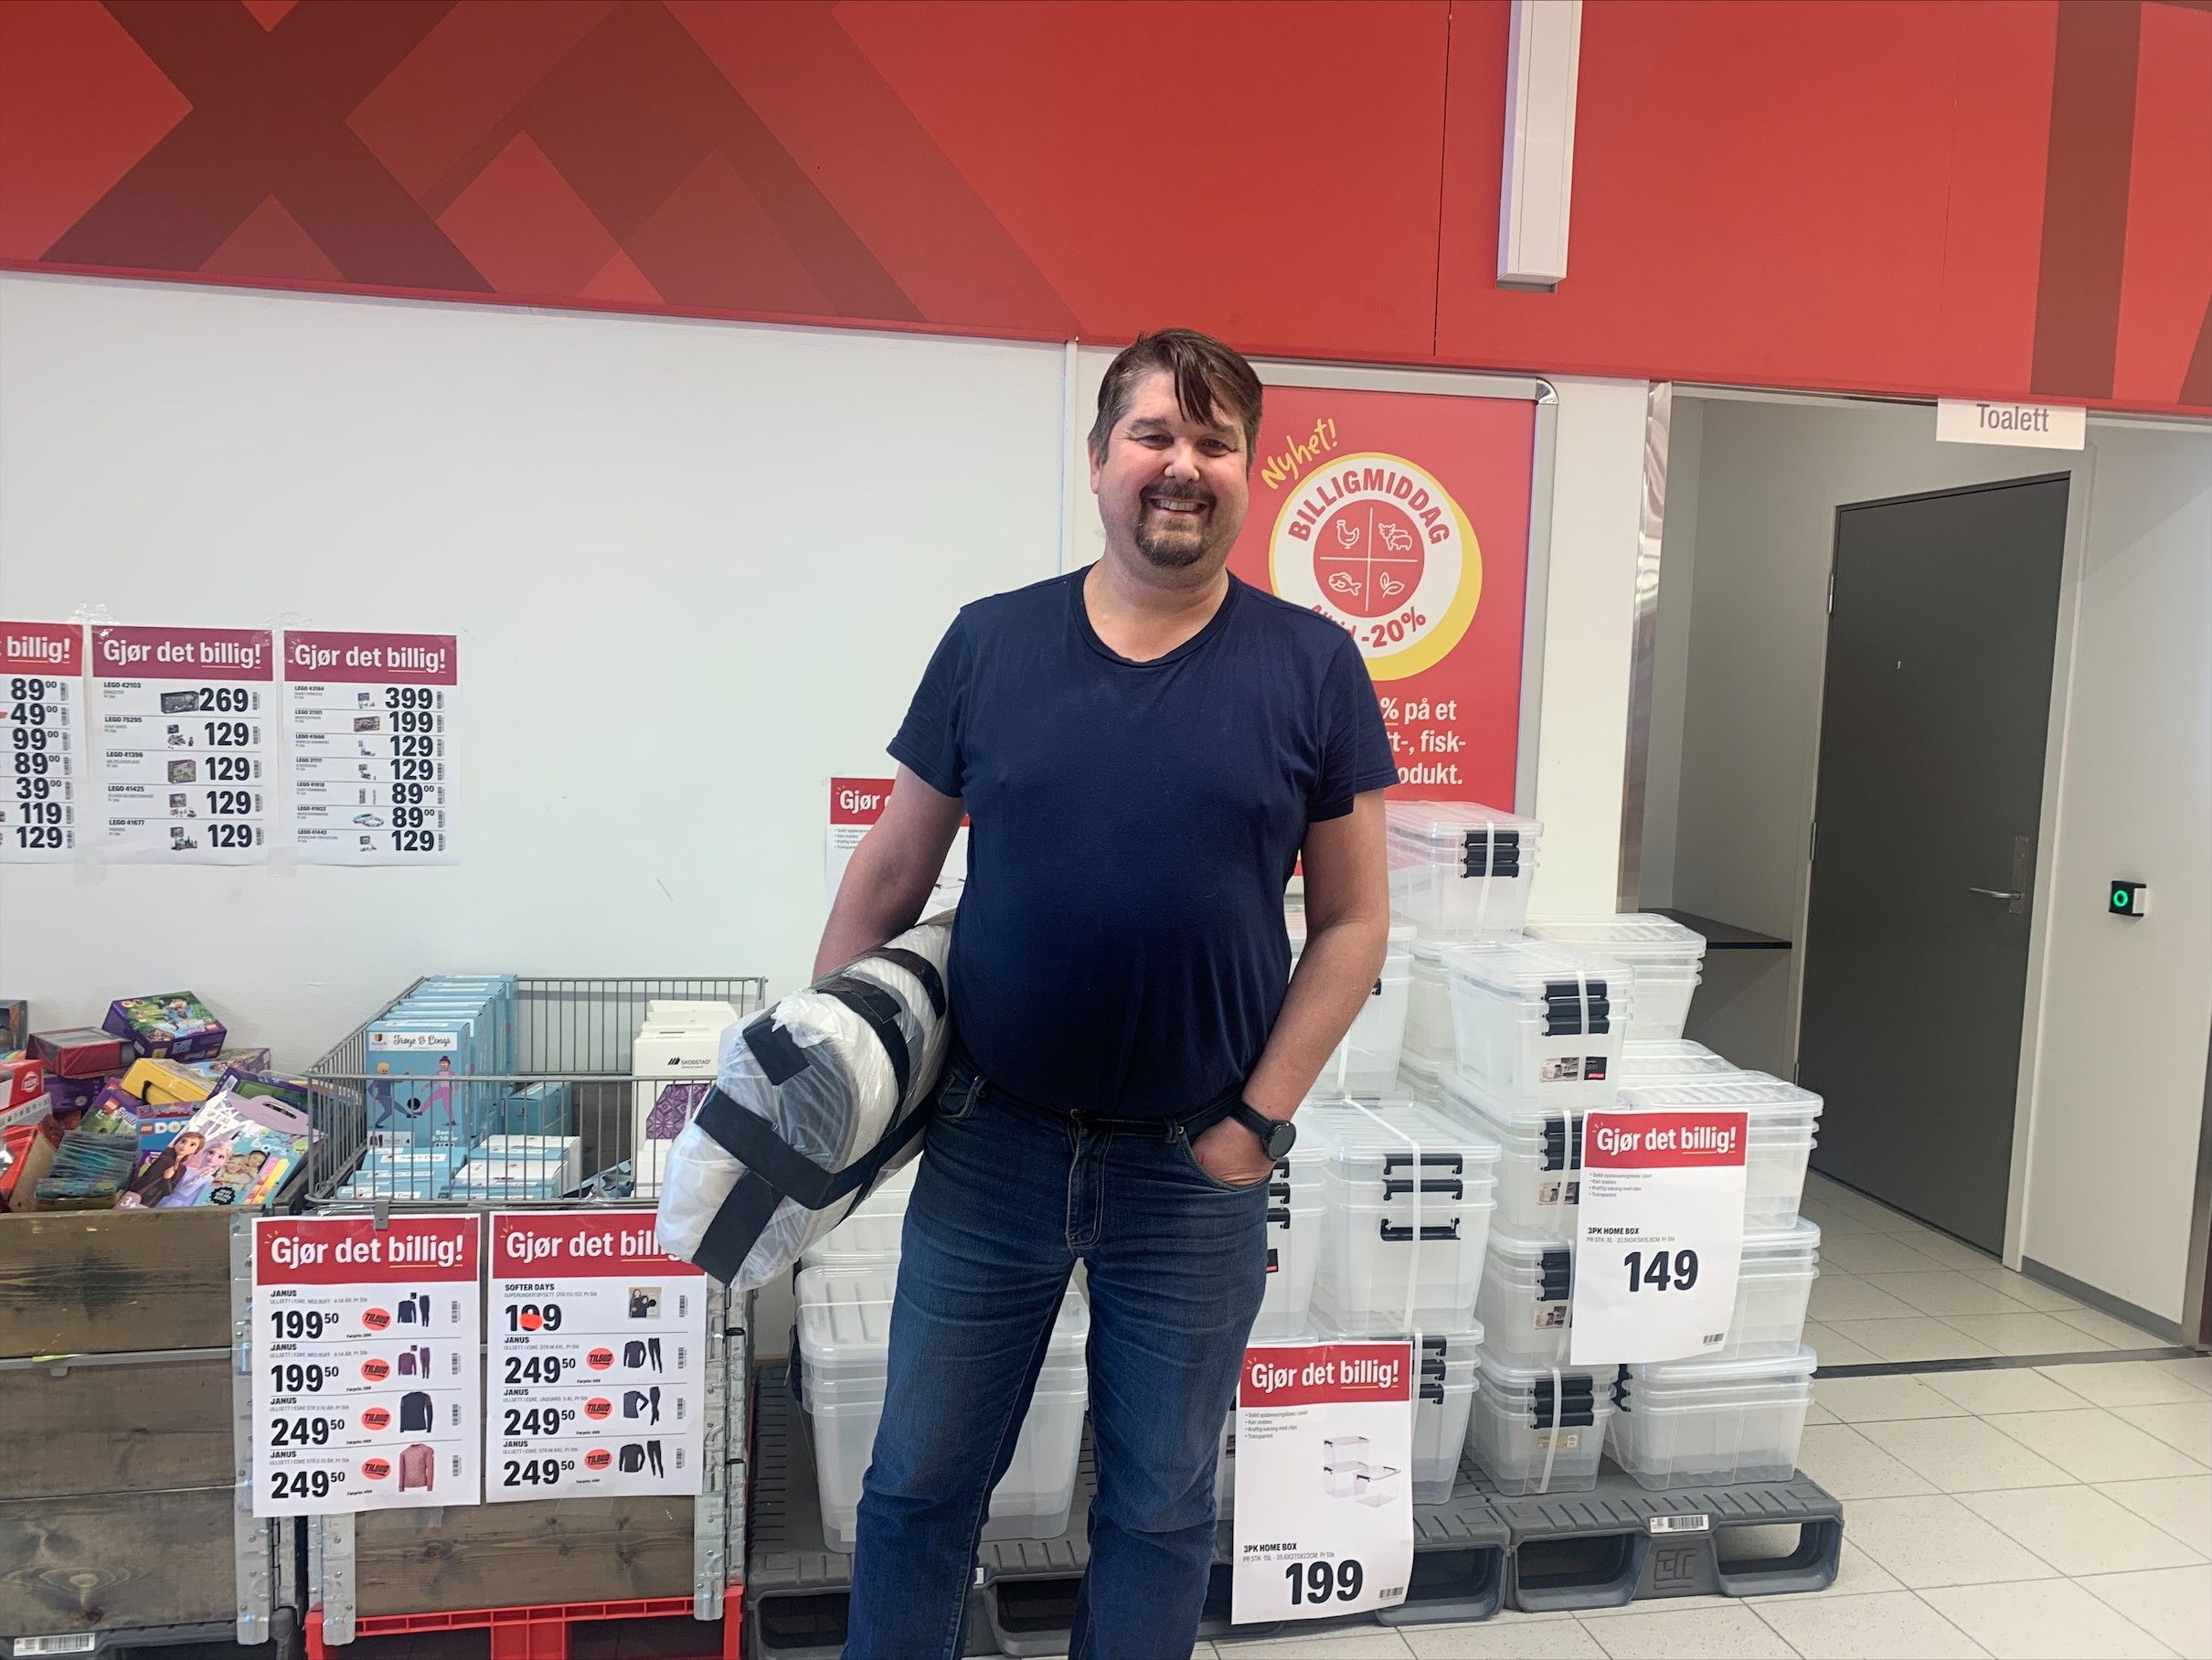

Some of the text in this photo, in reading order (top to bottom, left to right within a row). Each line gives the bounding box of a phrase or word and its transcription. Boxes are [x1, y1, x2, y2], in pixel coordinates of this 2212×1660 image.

[1976, 403, 2049, 432] Toalett
[1260, 417, 1338, 490] Nyhet!
[1287, 467, 1450, 545] BILLIGMIDDAG
[1361, 605, 1427, 648] -20%
[6, 635, 70, 664] billig!
[102, 639, 261, 669] Gjør det billig!
[294, 644, 446, 674] Gjør det billig!
[10, 677, 45, 701] 89
[199, 687, 249, 712] 269
[385, 686, 433, 709] 399
[11, 703, 46, 726] 49
[389, 710, 433, 733] 199
[1404, 697, 1430, 725] på
[1434, 698, 1457, 720] et
[12, 728, 48, 750] 99
[205, 722, 249, 747] 129
[389, 735, 433, 757] 129
[1420, 730, 1466, 752] fisk-
[15, 752, 48, 775] 89
[205, 757, 250, 781] 129
[390, 759, 434, 781] 129
[1398, 762, 1462, 785] odukt.
[16, 777, 49, 800] 39
[391, 782, 423, 804] 89
[19, 802, 62, 825] 119
[207, 791, 251, 814] 129
[839, 790, 880, 814] Gjør
[392, 806, 423, 828] 89
[16, 826, 63, 848] 129
[207, 824, 252, 848] 129
[391, 830, 434, 852] 129
[1597, 1126, 1737, 1156] Gjør det billig!
[1587, 1227, 1602, 1235] 3PK
[271, 1234, 463, 1270] Gjør det billig!
[506, 1231, 563, 1263] Gjør
[569, 1231, 613, 1256] det
[1623, 1250, 1699, 1293] 149
[271, 1310, 339, 1339] 199 50
[271, 1364, 339, 1393] 199 50
[505, 1357, 576, 1384] 249 50
[1250, 1358, 1399, 1394] Gjør det billig!
[271, 1418, 345, 1446] 249 50
[504, 1408, 575, 1436] 249 50
[271, 1471, 345, 1499] 249 50
[503, 1459, 575, 1486] 249 50
[1243, 1542, 1297, 1553] 3PK HOME BOX
[1285, 1559, 1364, 1605] 199
